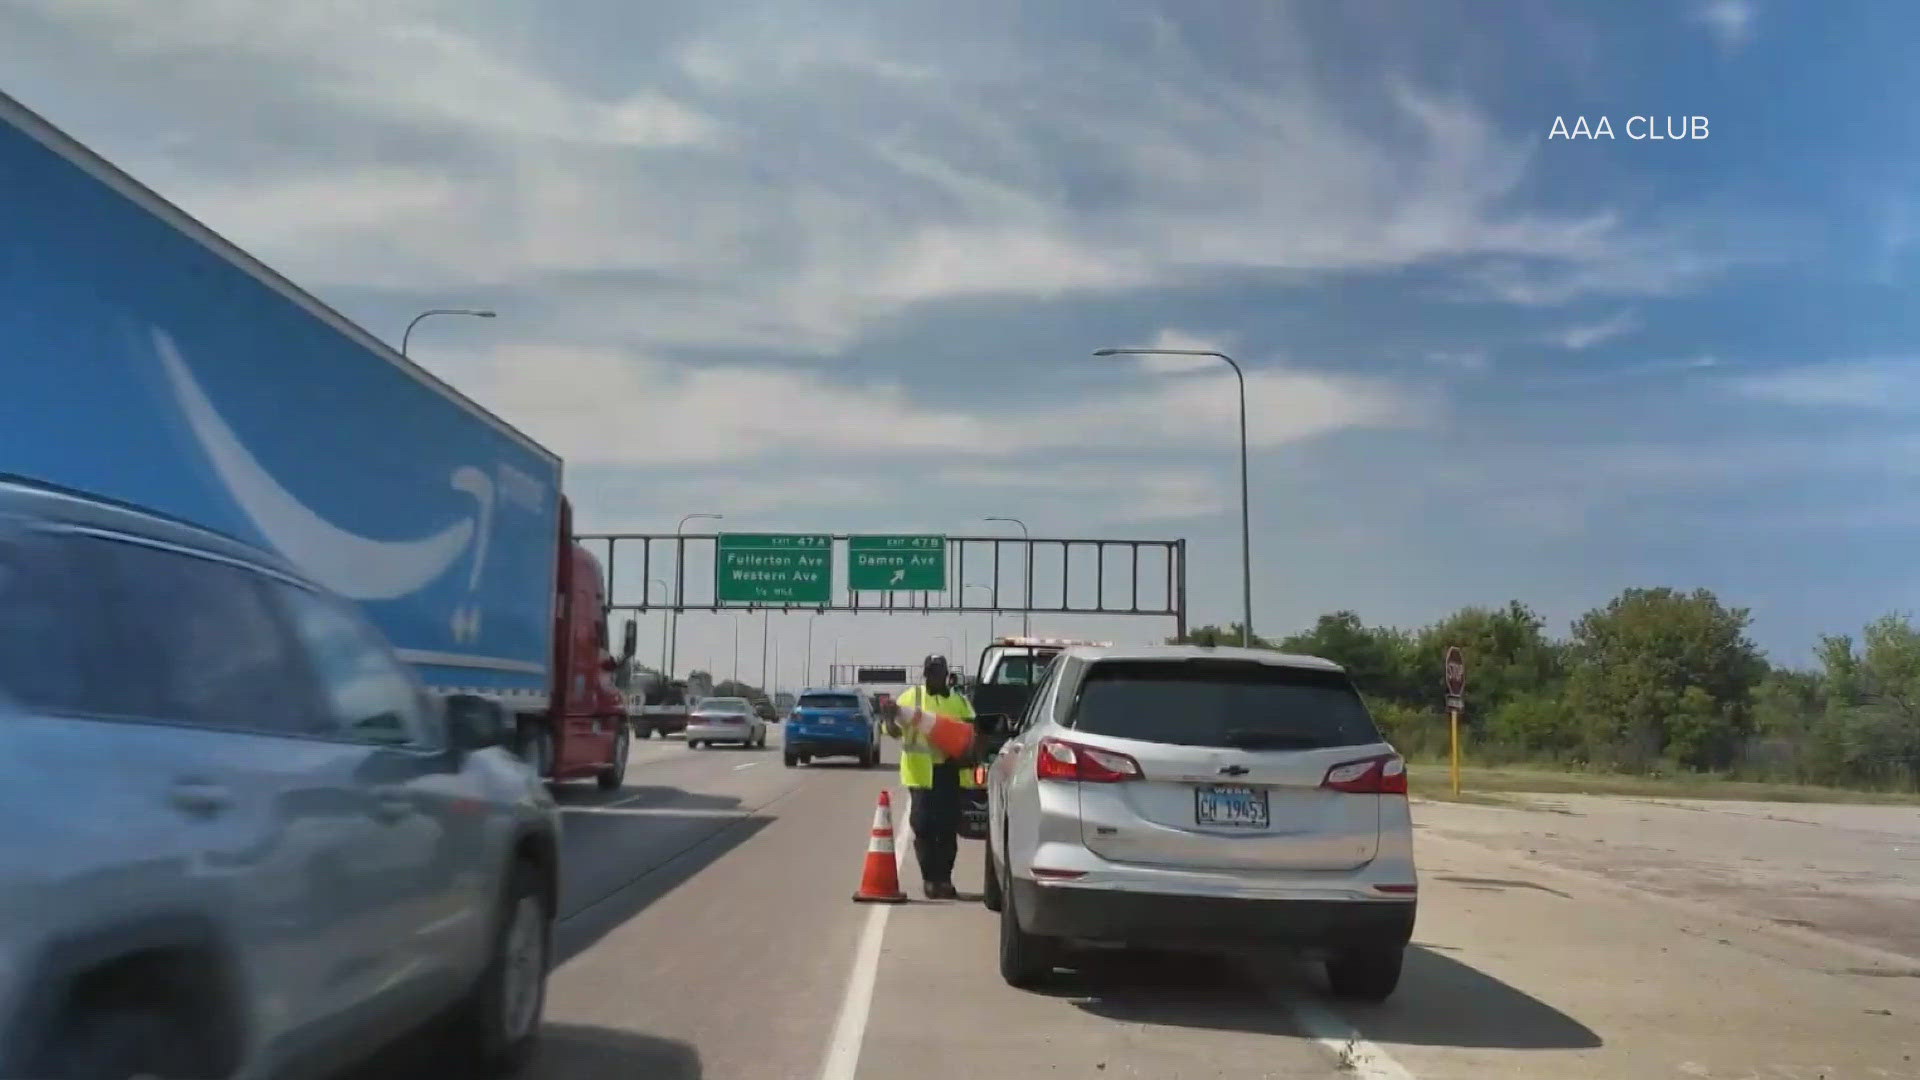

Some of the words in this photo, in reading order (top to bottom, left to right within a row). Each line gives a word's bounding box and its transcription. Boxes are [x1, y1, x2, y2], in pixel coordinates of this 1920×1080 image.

[772, 538, 790, 546] EXIT
[887, 539, 905, 547] EXIT
[727, 553, 791, 566] Fullerton
[799, 554, 823, 566] Ave
[859, 554, 904, 566] Damen
[911, 554, 936, 566] Ave
[732, 569, 786, 581] Western
[793, 570, 818, 581] Ave
[1201, 800, 1217, 818] CH
